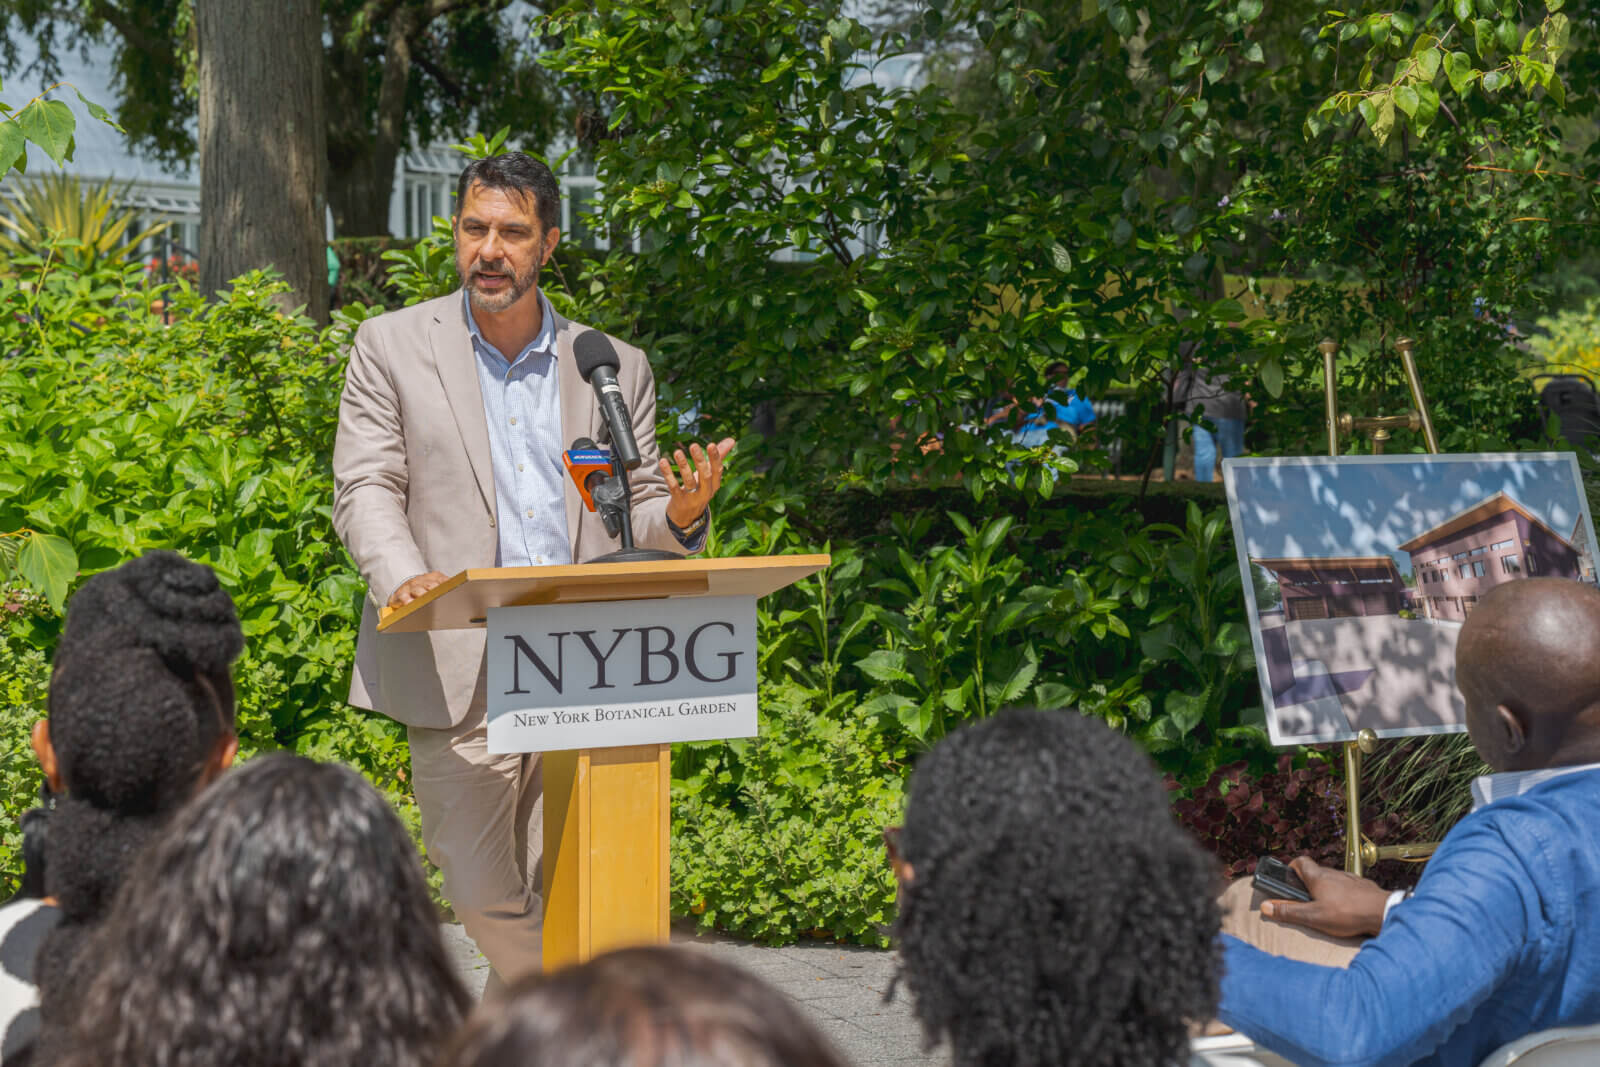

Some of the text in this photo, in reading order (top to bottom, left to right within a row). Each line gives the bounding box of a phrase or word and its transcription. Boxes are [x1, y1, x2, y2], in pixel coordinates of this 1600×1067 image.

[503, 621, 745, 695] NYBG
[513, 701, 738, 728] NEW YORK BOTANICAL GARDEN
